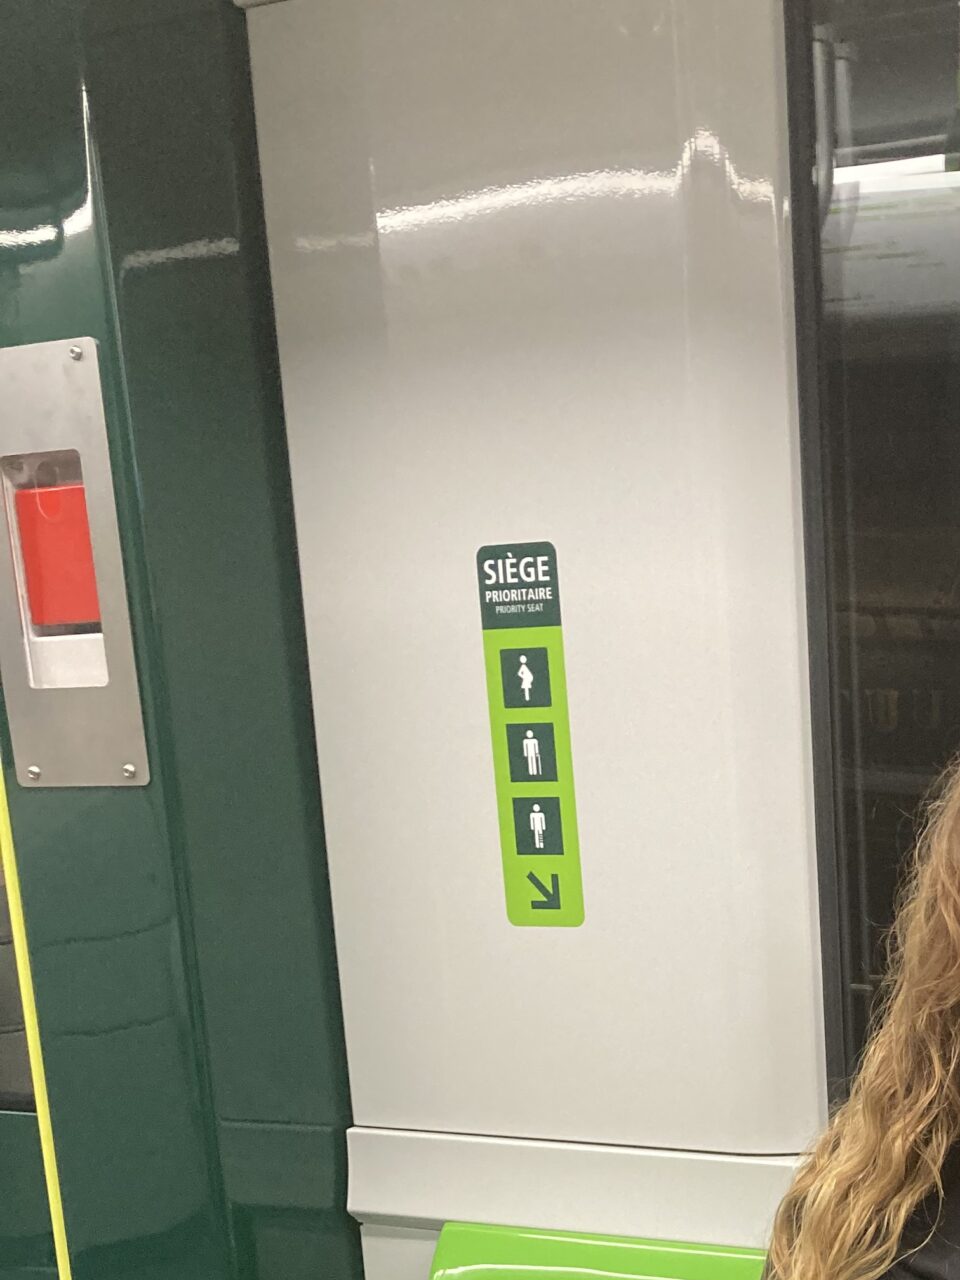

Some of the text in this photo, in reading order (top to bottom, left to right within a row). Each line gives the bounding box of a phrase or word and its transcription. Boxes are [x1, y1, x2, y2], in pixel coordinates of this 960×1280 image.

[483, 552, 550, 585] SIÈGE
[485, 587, 553, 603] PRIORITAIRE
[495, 603, 544, 614] PRIORITY SEAT
